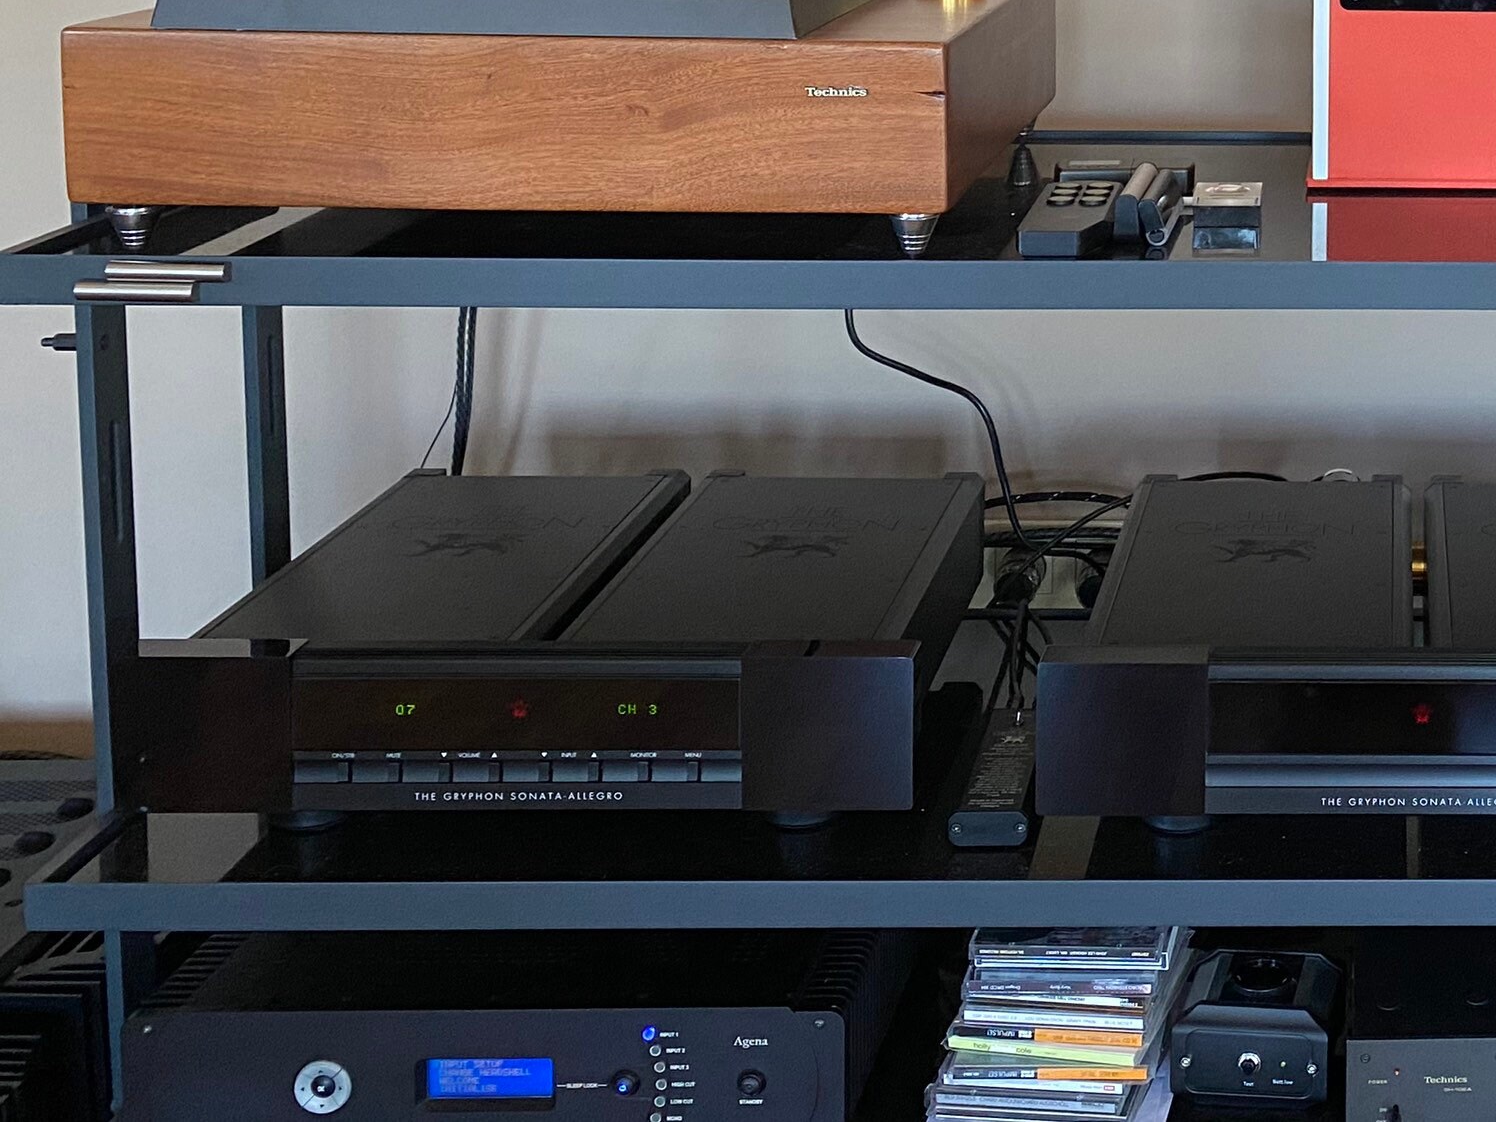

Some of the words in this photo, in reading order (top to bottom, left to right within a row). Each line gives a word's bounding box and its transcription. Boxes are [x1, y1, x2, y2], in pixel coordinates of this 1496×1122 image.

[805, 85, 868, 99] Technics
[395, 704, 415, 715] 07
[617, 705, 637, 715] CH
[648, 705, 657, 715] 3
[414, 792, 436, 802] THE
[443, 791, 504, 802] GRYPHON
[1321, 798, 1342, 806] THE
[1349, 797, 1406, 806] GRYPHON
[733, 1036, 768, 1048] Agena
